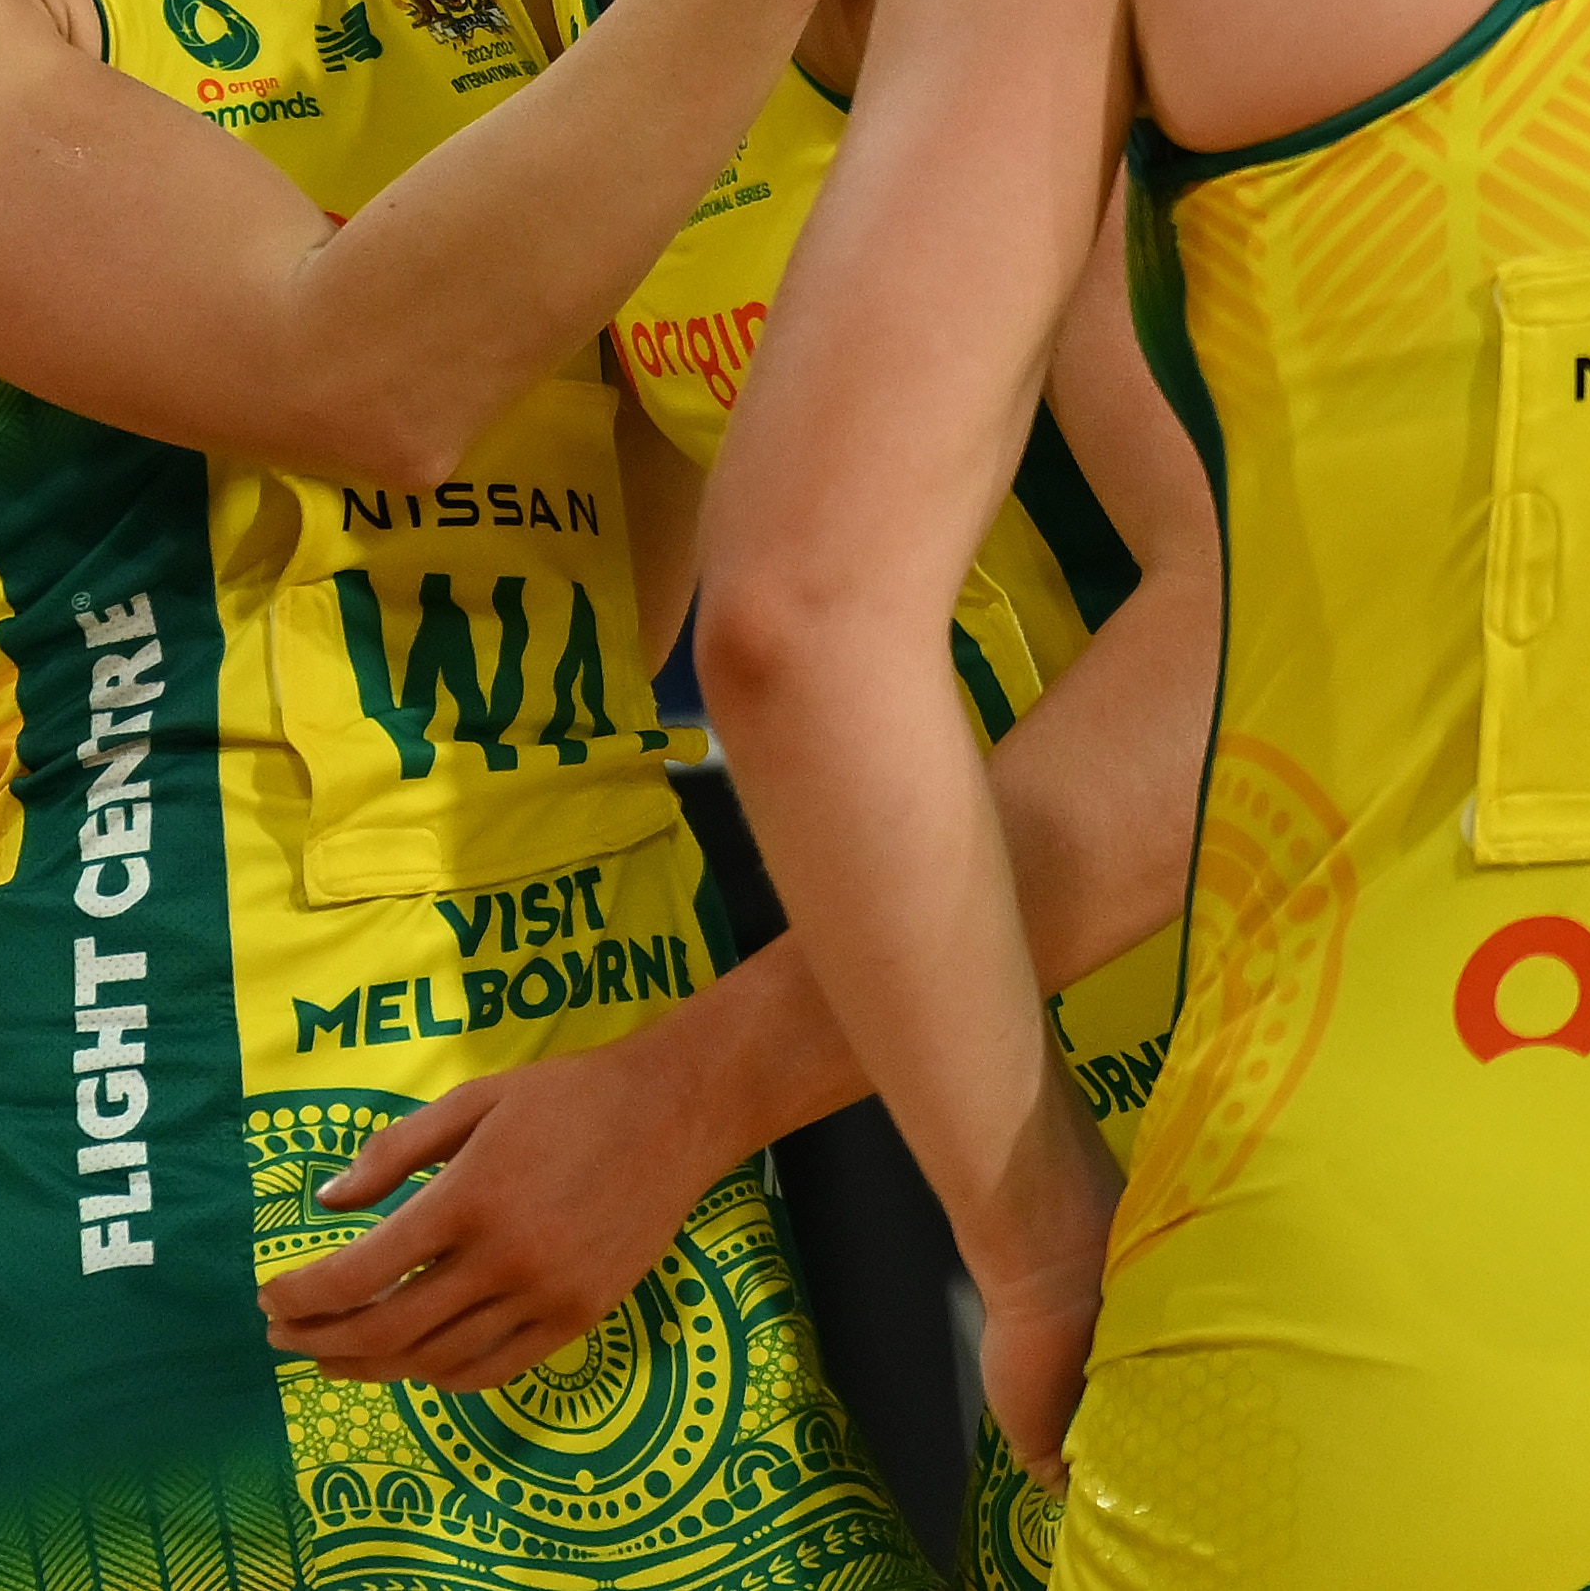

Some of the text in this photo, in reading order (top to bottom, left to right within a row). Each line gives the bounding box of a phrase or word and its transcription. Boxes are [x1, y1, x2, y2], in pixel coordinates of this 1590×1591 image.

[228, 77, 280, 99] origin
[341, 482, 601, 537] NISSAN
[72, 591, 167, 1276] FLIGHT CENTRE
[433, 865, 606, 959] VISIT
